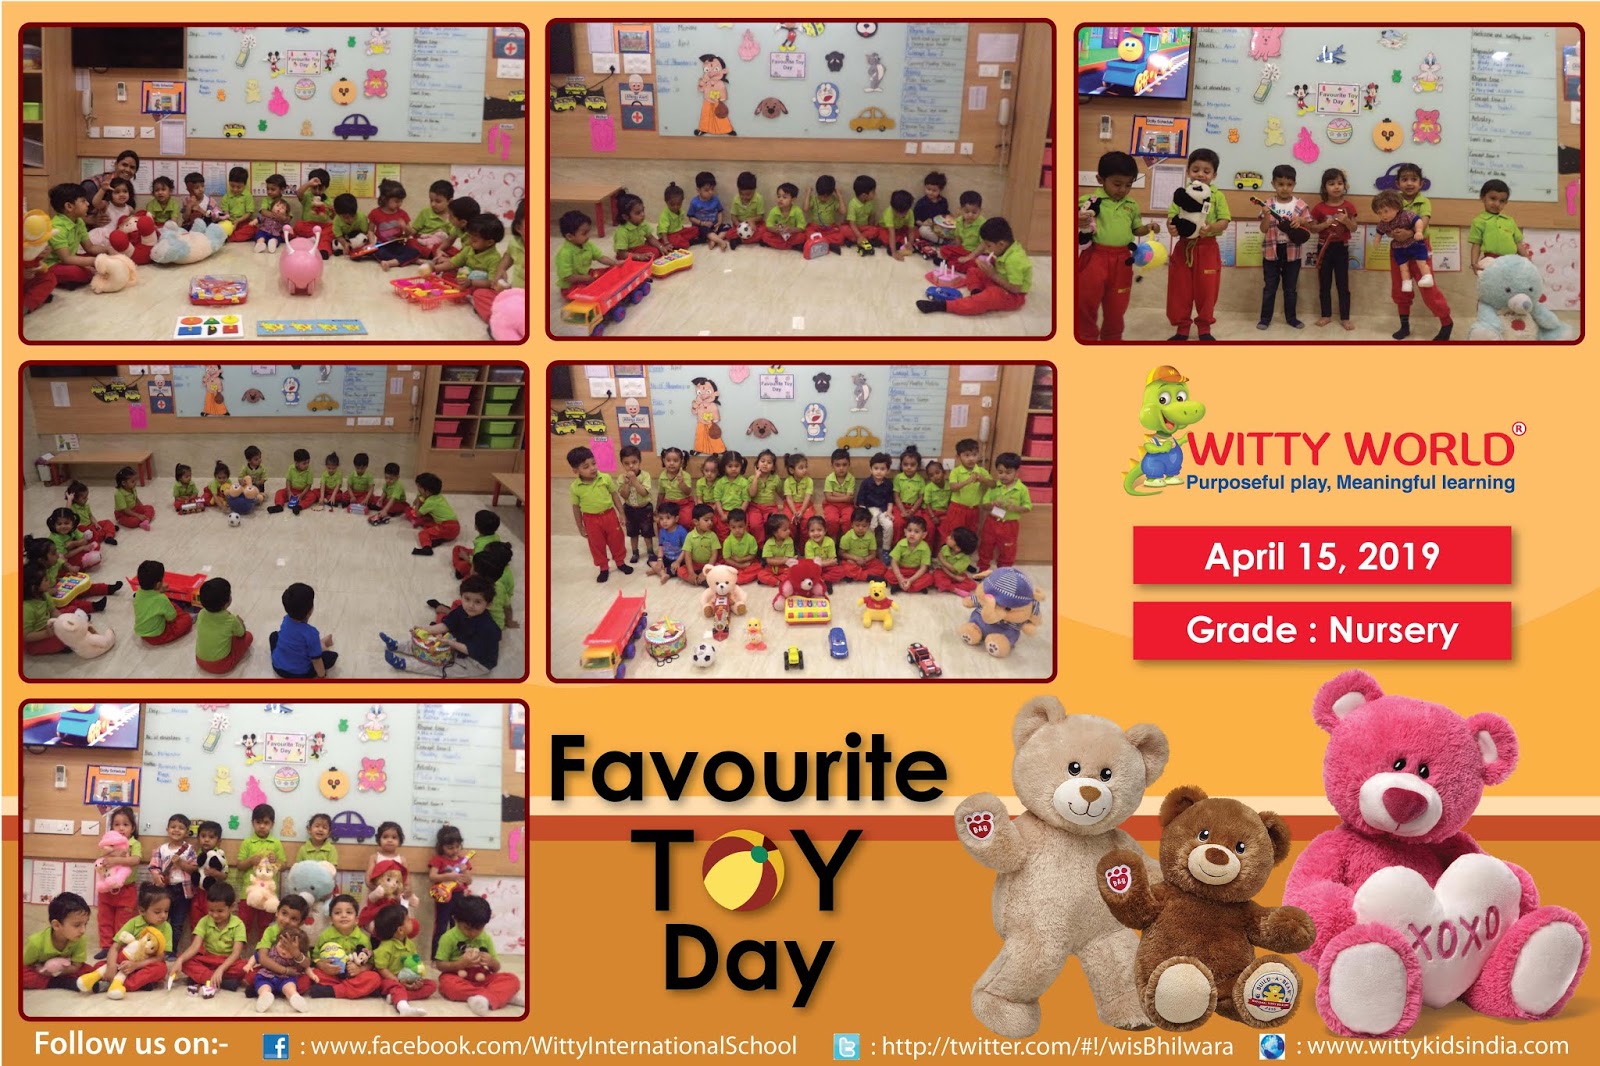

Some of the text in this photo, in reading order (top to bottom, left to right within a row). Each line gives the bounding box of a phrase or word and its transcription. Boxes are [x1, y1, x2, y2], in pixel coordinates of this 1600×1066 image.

[972, 824, 989, 834] BAB
[1112, 876, 1126, 887] BAB
[1407, 905, 1501, 961] XOXO
